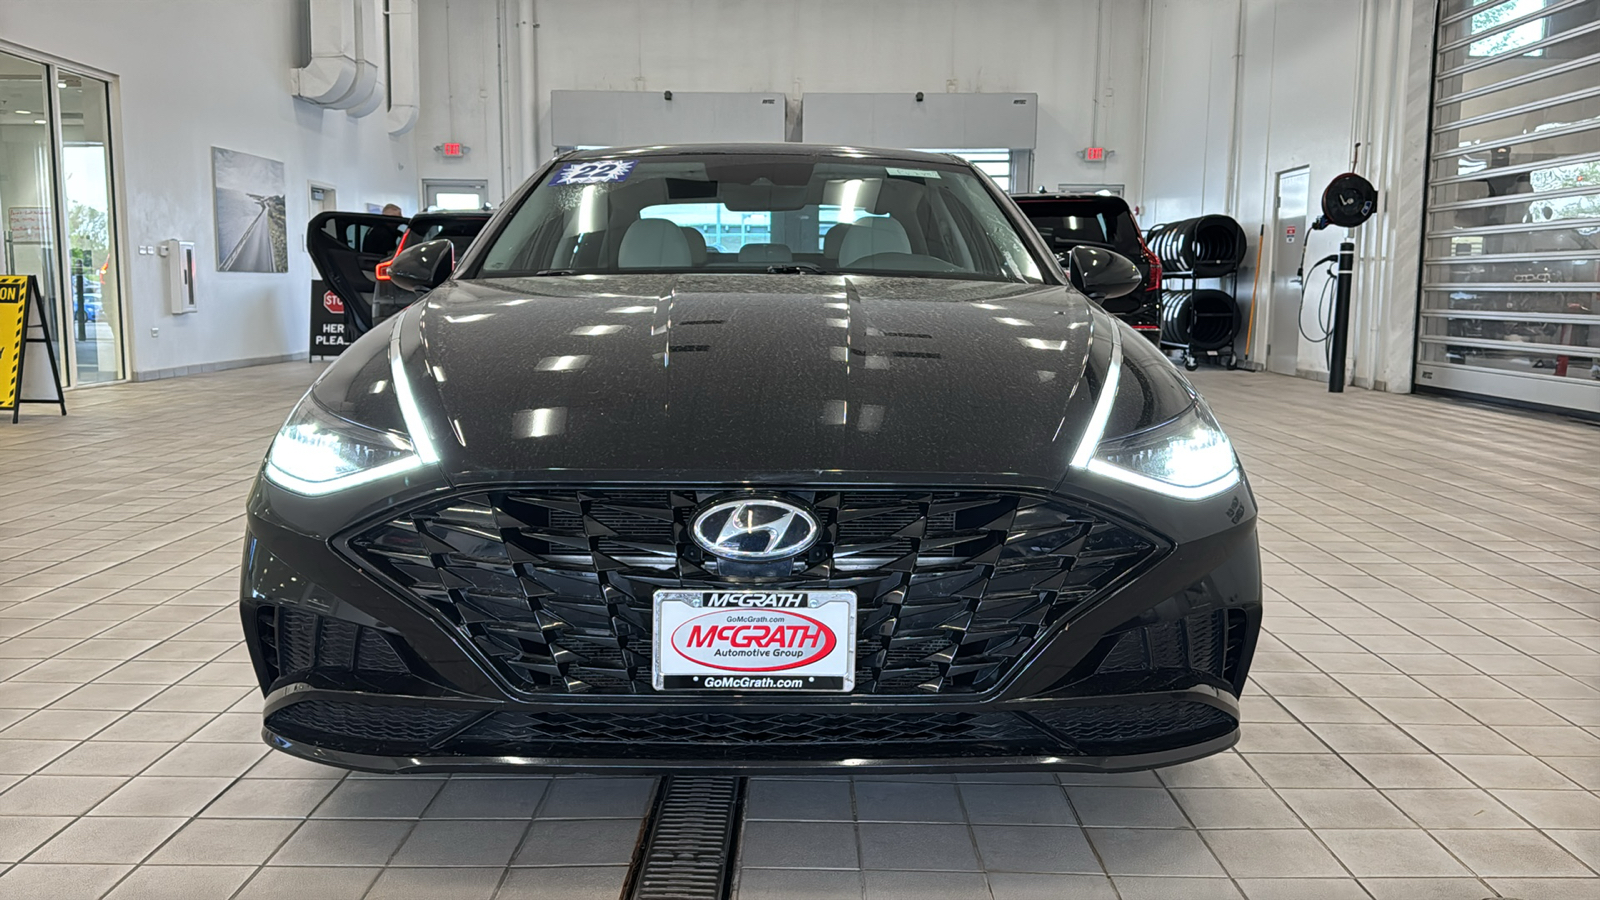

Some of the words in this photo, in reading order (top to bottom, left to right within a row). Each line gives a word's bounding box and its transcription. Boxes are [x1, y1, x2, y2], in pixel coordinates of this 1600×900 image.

[571, 164, 617, 179] 22
[325, 295, 343, 305] STO
[322, 323, 345, 333] HER
[315, 335, 351, 345] PLEA
[726, 615, 785, 623] GoMcGrath.com
[714, 648, 770, 657] Automotive
[773, 649, 804, 658] Group
[704, 676, 803, 688] GoMcGrath.com
